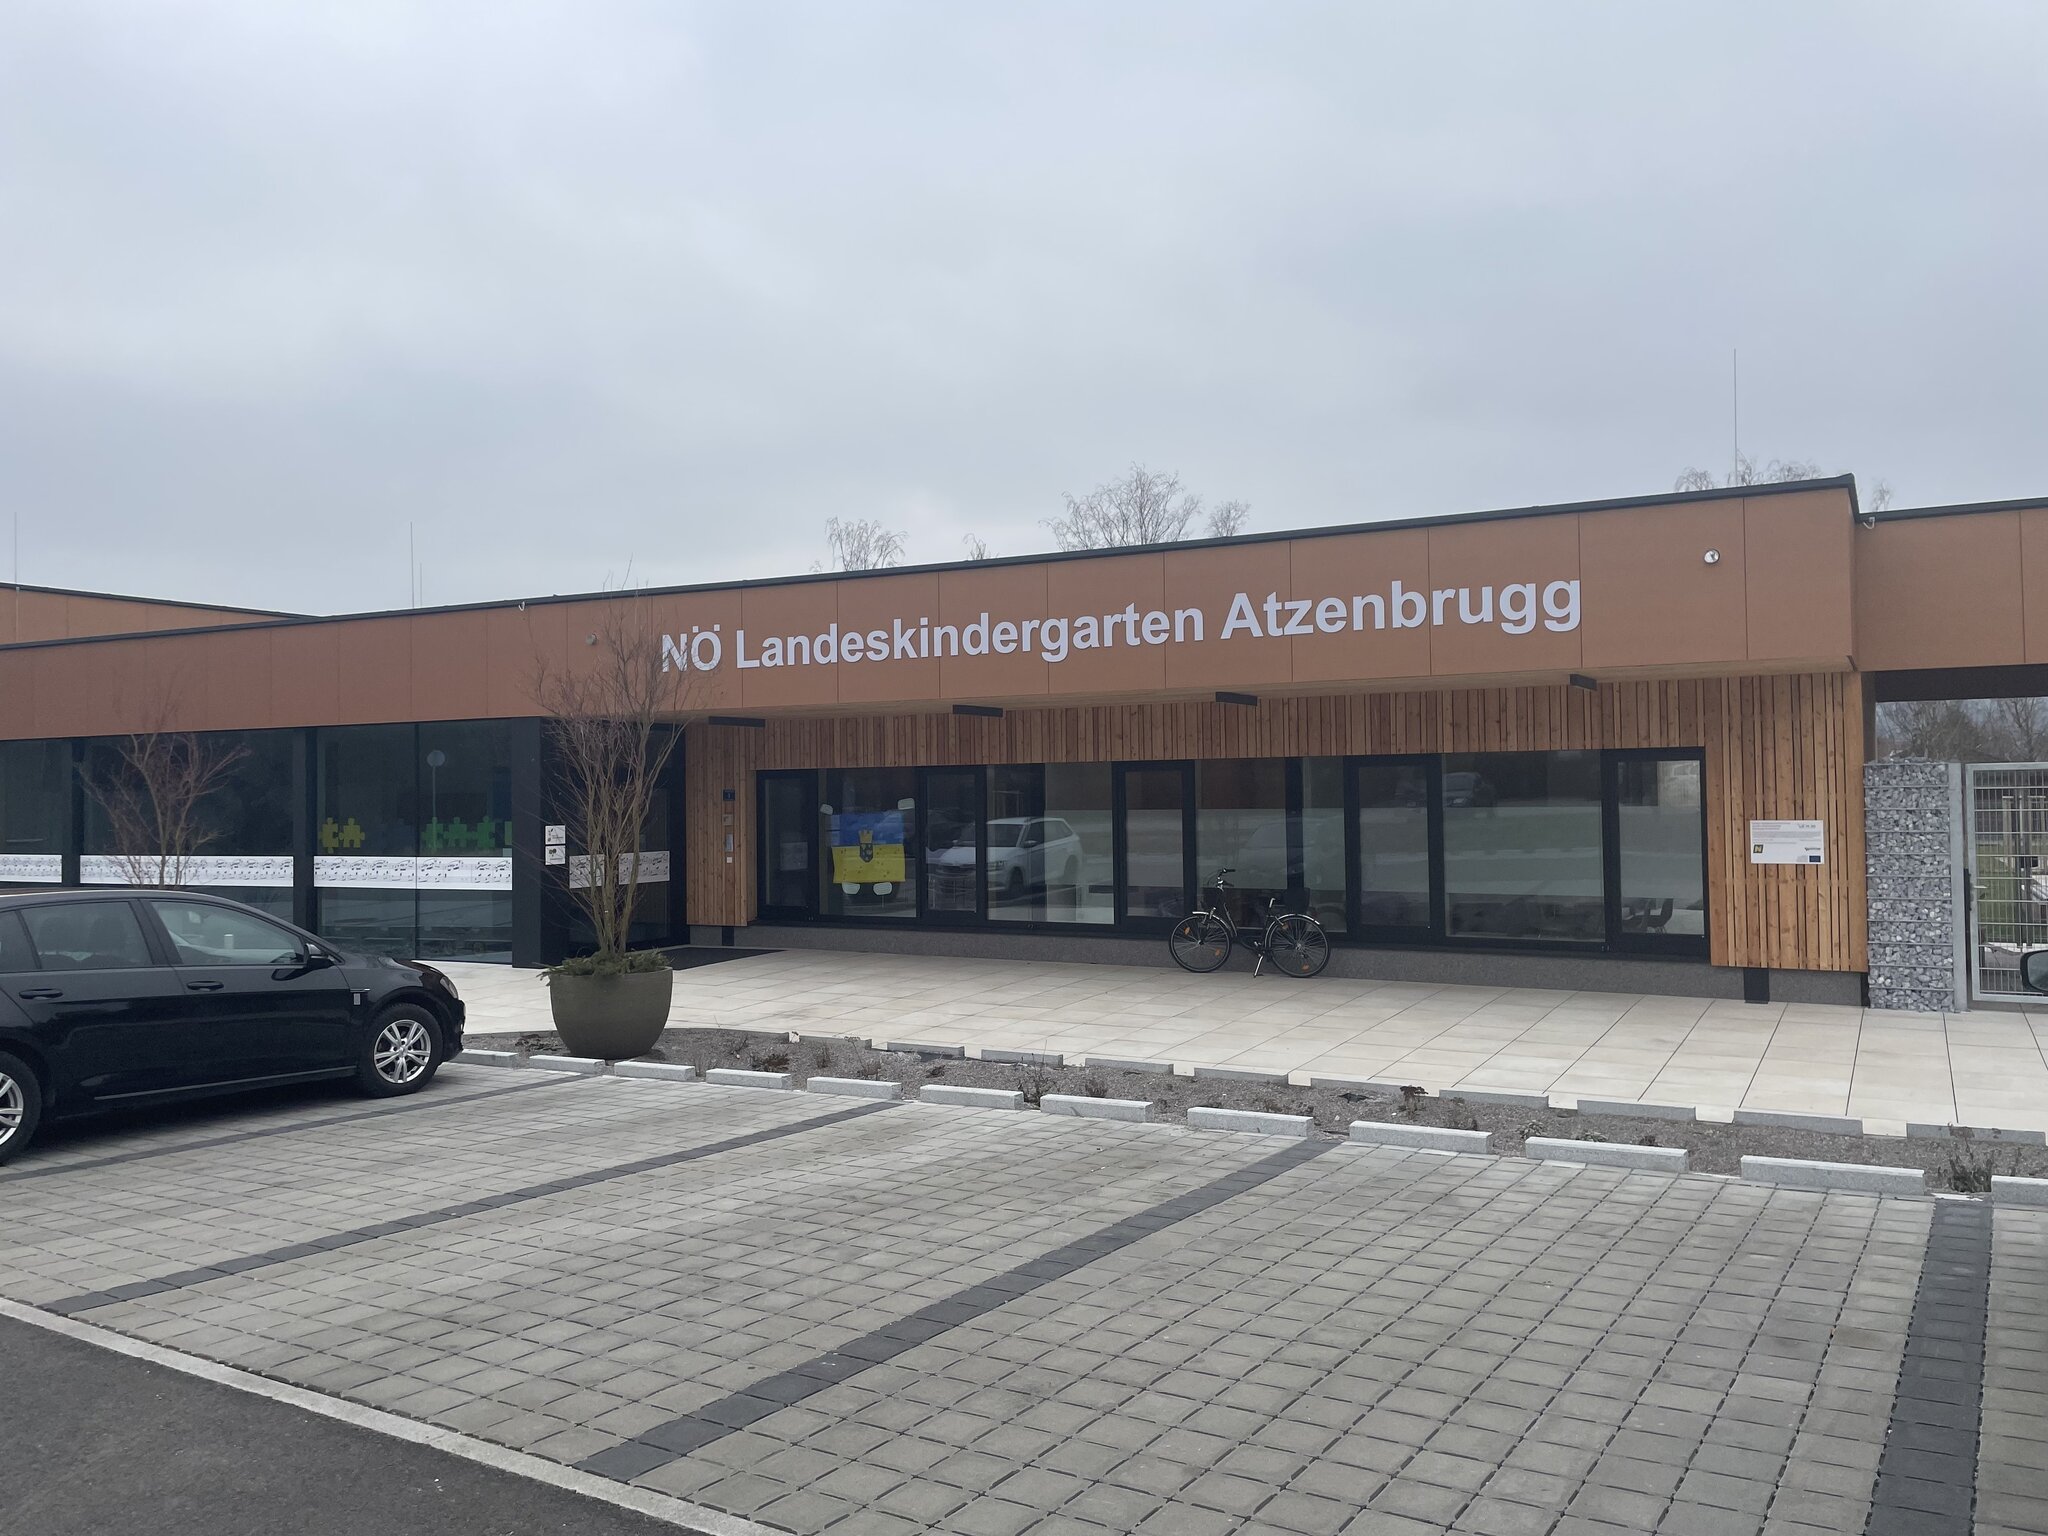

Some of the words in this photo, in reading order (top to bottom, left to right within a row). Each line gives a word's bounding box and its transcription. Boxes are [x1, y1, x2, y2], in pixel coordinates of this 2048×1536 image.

[662, 624, 721, 672] NÖ
[736, 606, 1205, 669] Landeskindergarten
[1220, 579, 1582, 640] Atzenbrugg
